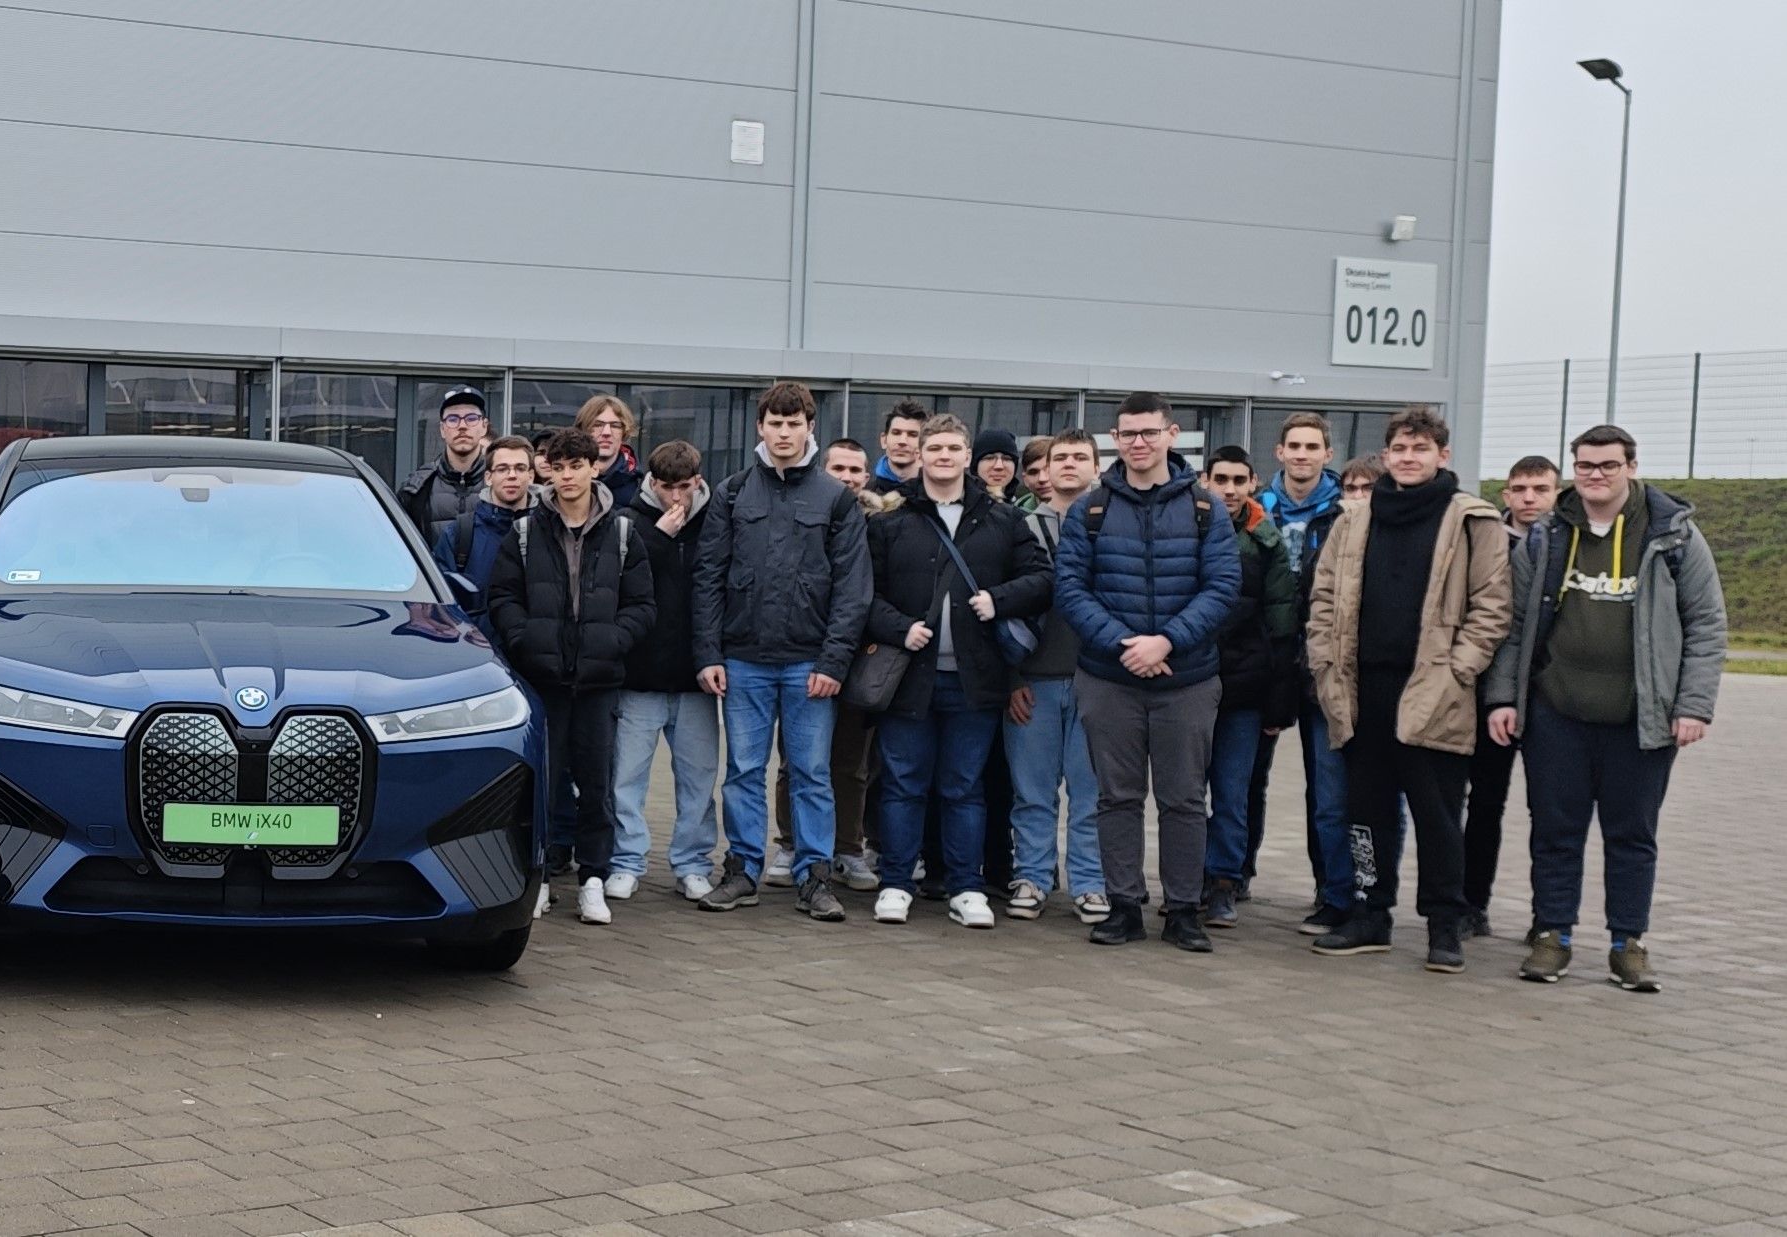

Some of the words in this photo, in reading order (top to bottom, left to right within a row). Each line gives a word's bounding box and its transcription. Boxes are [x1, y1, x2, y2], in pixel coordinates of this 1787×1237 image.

[1347, 305, 1426, 347] 012.0
[211, 812, 252, 828] BMW
[256, 813, 292, 829] iX40
